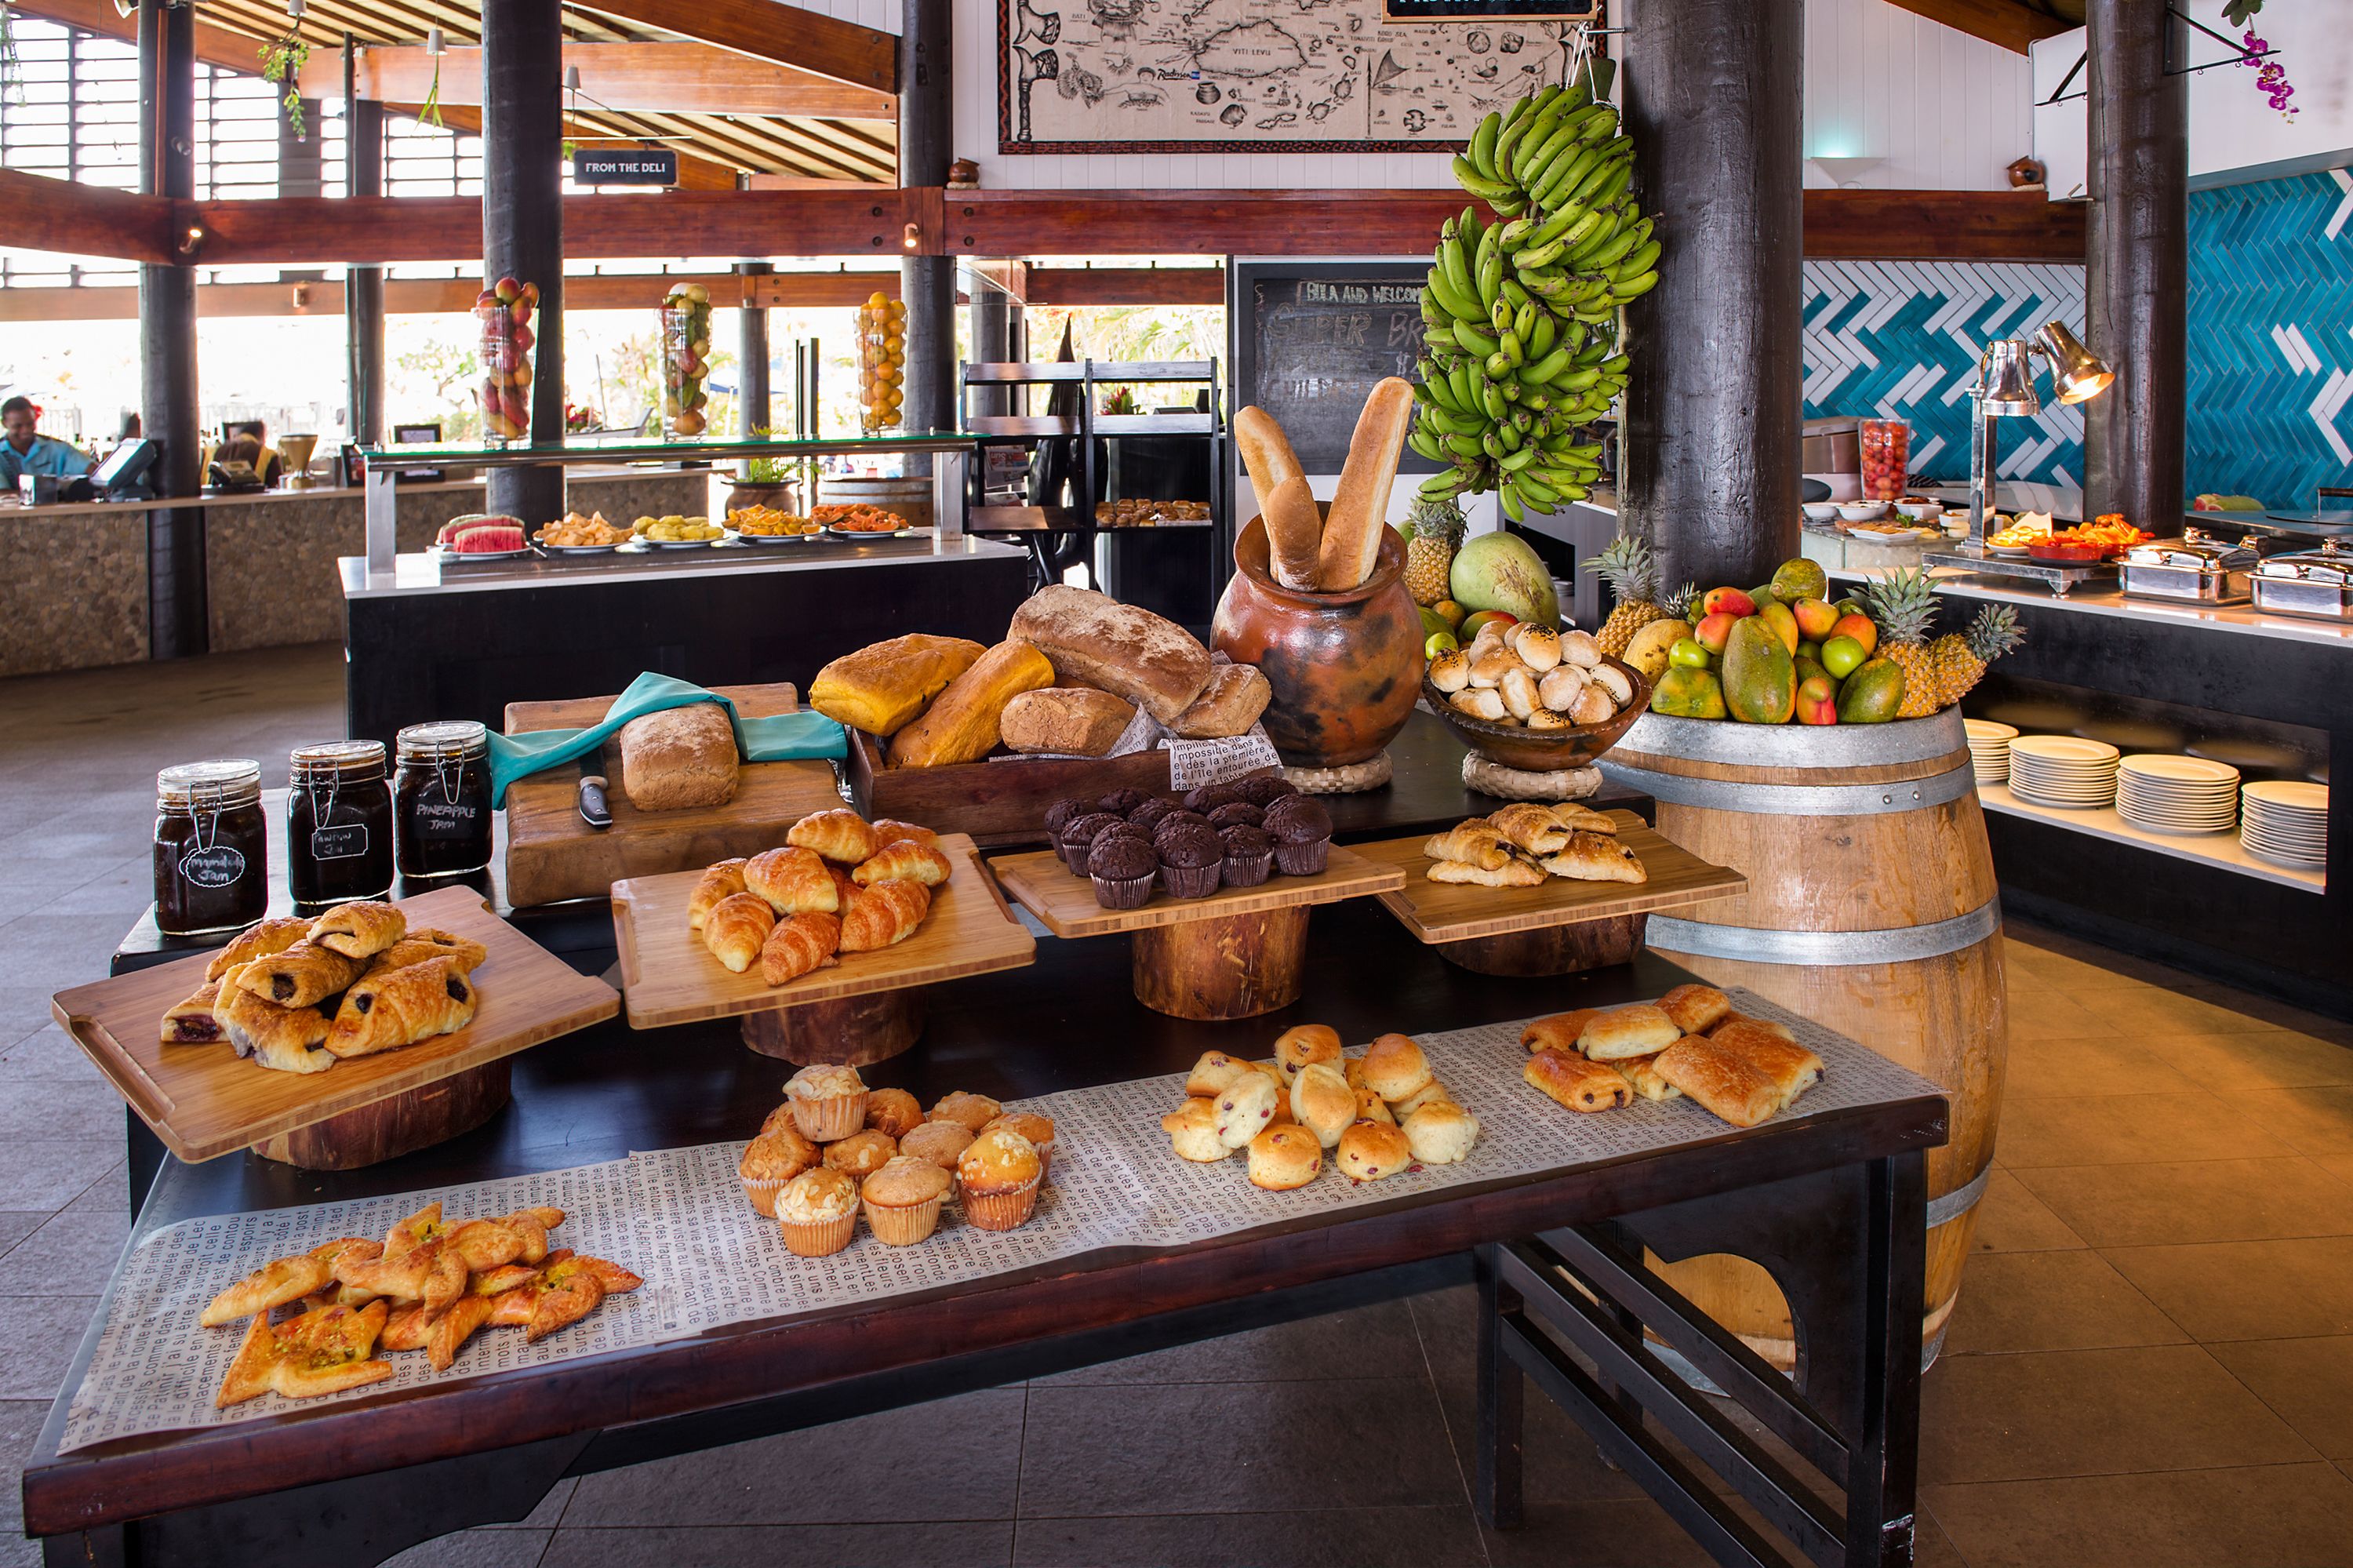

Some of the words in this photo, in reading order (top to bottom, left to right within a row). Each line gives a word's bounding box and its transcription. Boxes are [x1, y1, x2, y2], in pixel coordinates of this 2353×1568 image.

[1252, 48, 1271, 56] LEVU
[586, 162, 616, 173] FROM
[619, 162, 638, 173] THE
[642, 162, 666, 173] DELI
[1343, 286, 1369, 304] AND
[1373, 286, 1422, 304] WELCOM
[1232, 739, 1253, 751] dans
[1186, 760, 1205, 770] dès
[1223, 745, 1265, 765] première
[1174, 771, 1187, 780] de
[1217, 758, 1260, 775] entourée
[416, 803, 476, 818] PINEAPPLE
[427, 819, 456, 830] JAM
